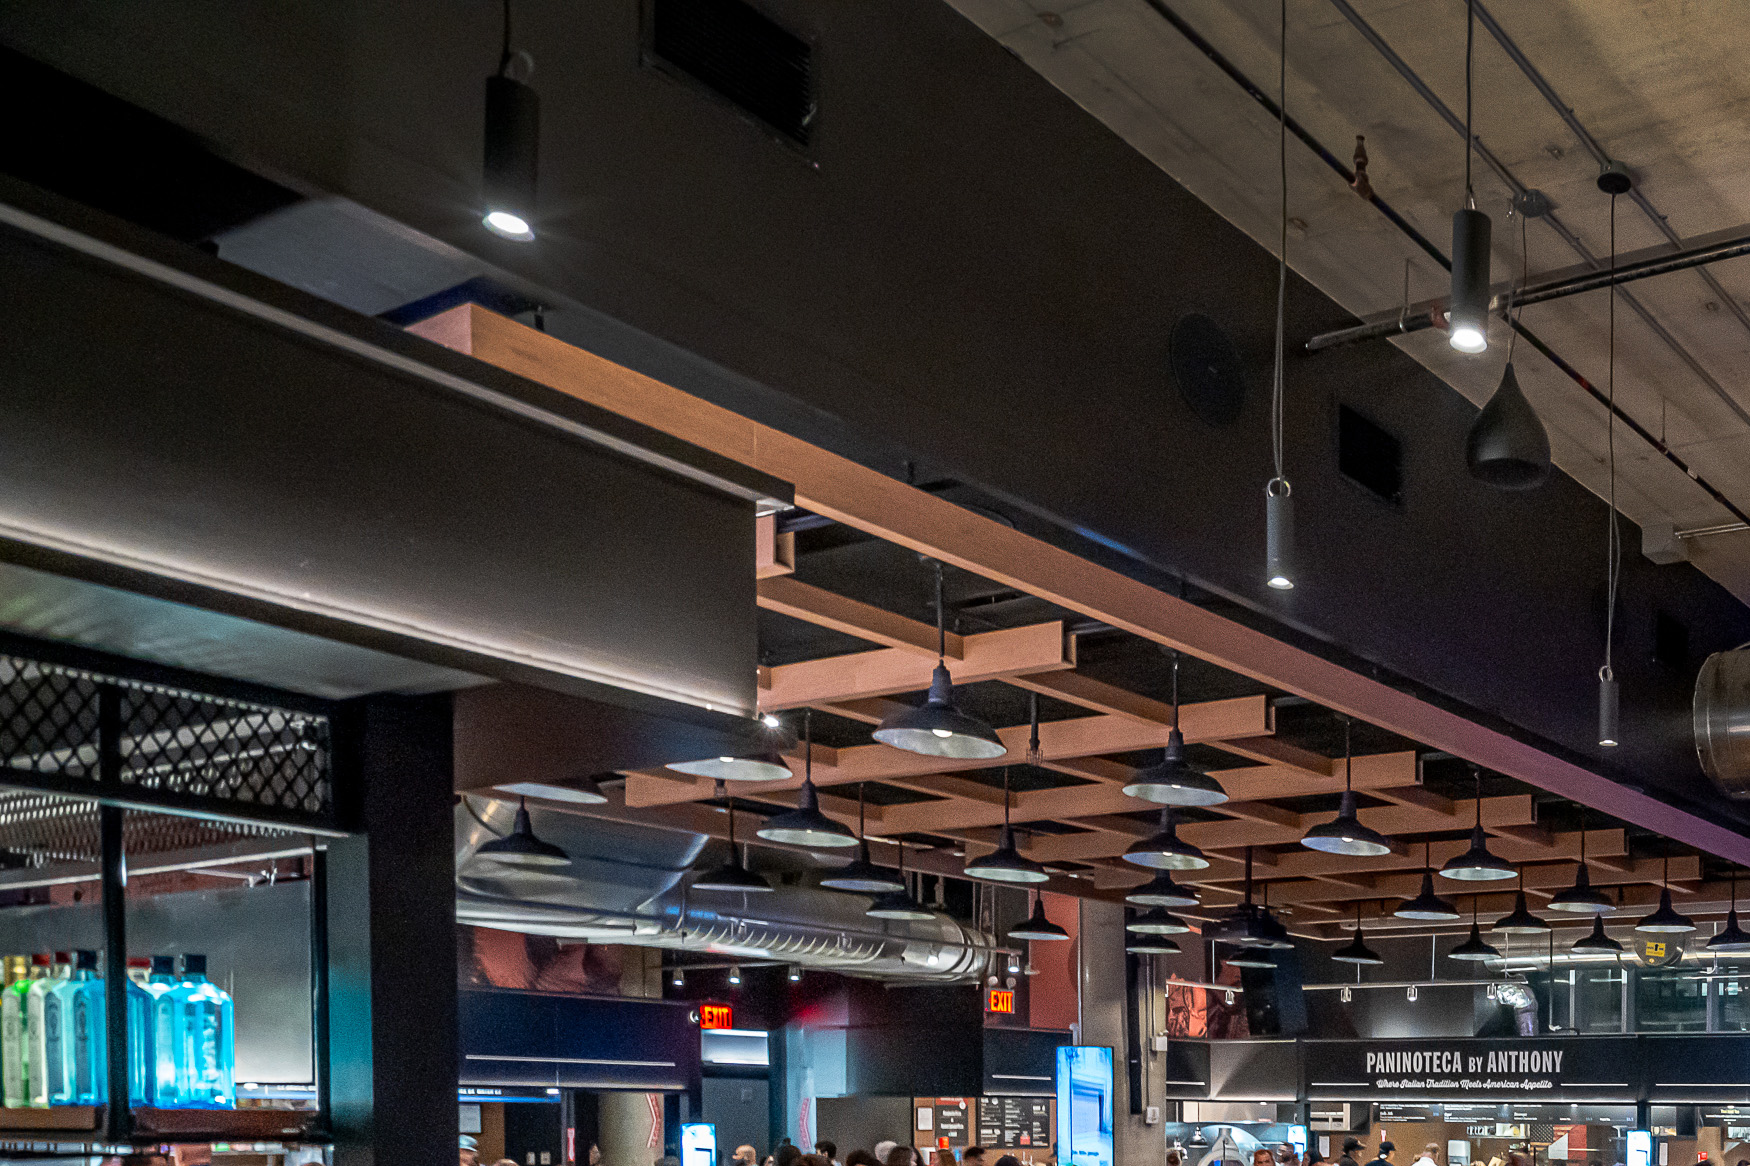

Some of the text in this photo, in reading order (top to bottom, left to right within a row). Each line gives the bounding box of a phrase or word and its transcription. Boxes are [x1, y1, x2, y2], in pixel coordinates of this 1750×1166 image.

[990, 991, 1013, 1012] EXIT
[704, 1006, 729, 1028] EXIT
[1366, 1050, 1563, 1073] PANINOTECA BY ANTHONY
[1376, 1078, 1553, 1090] Where Italian Tradition Meets American Appetite
